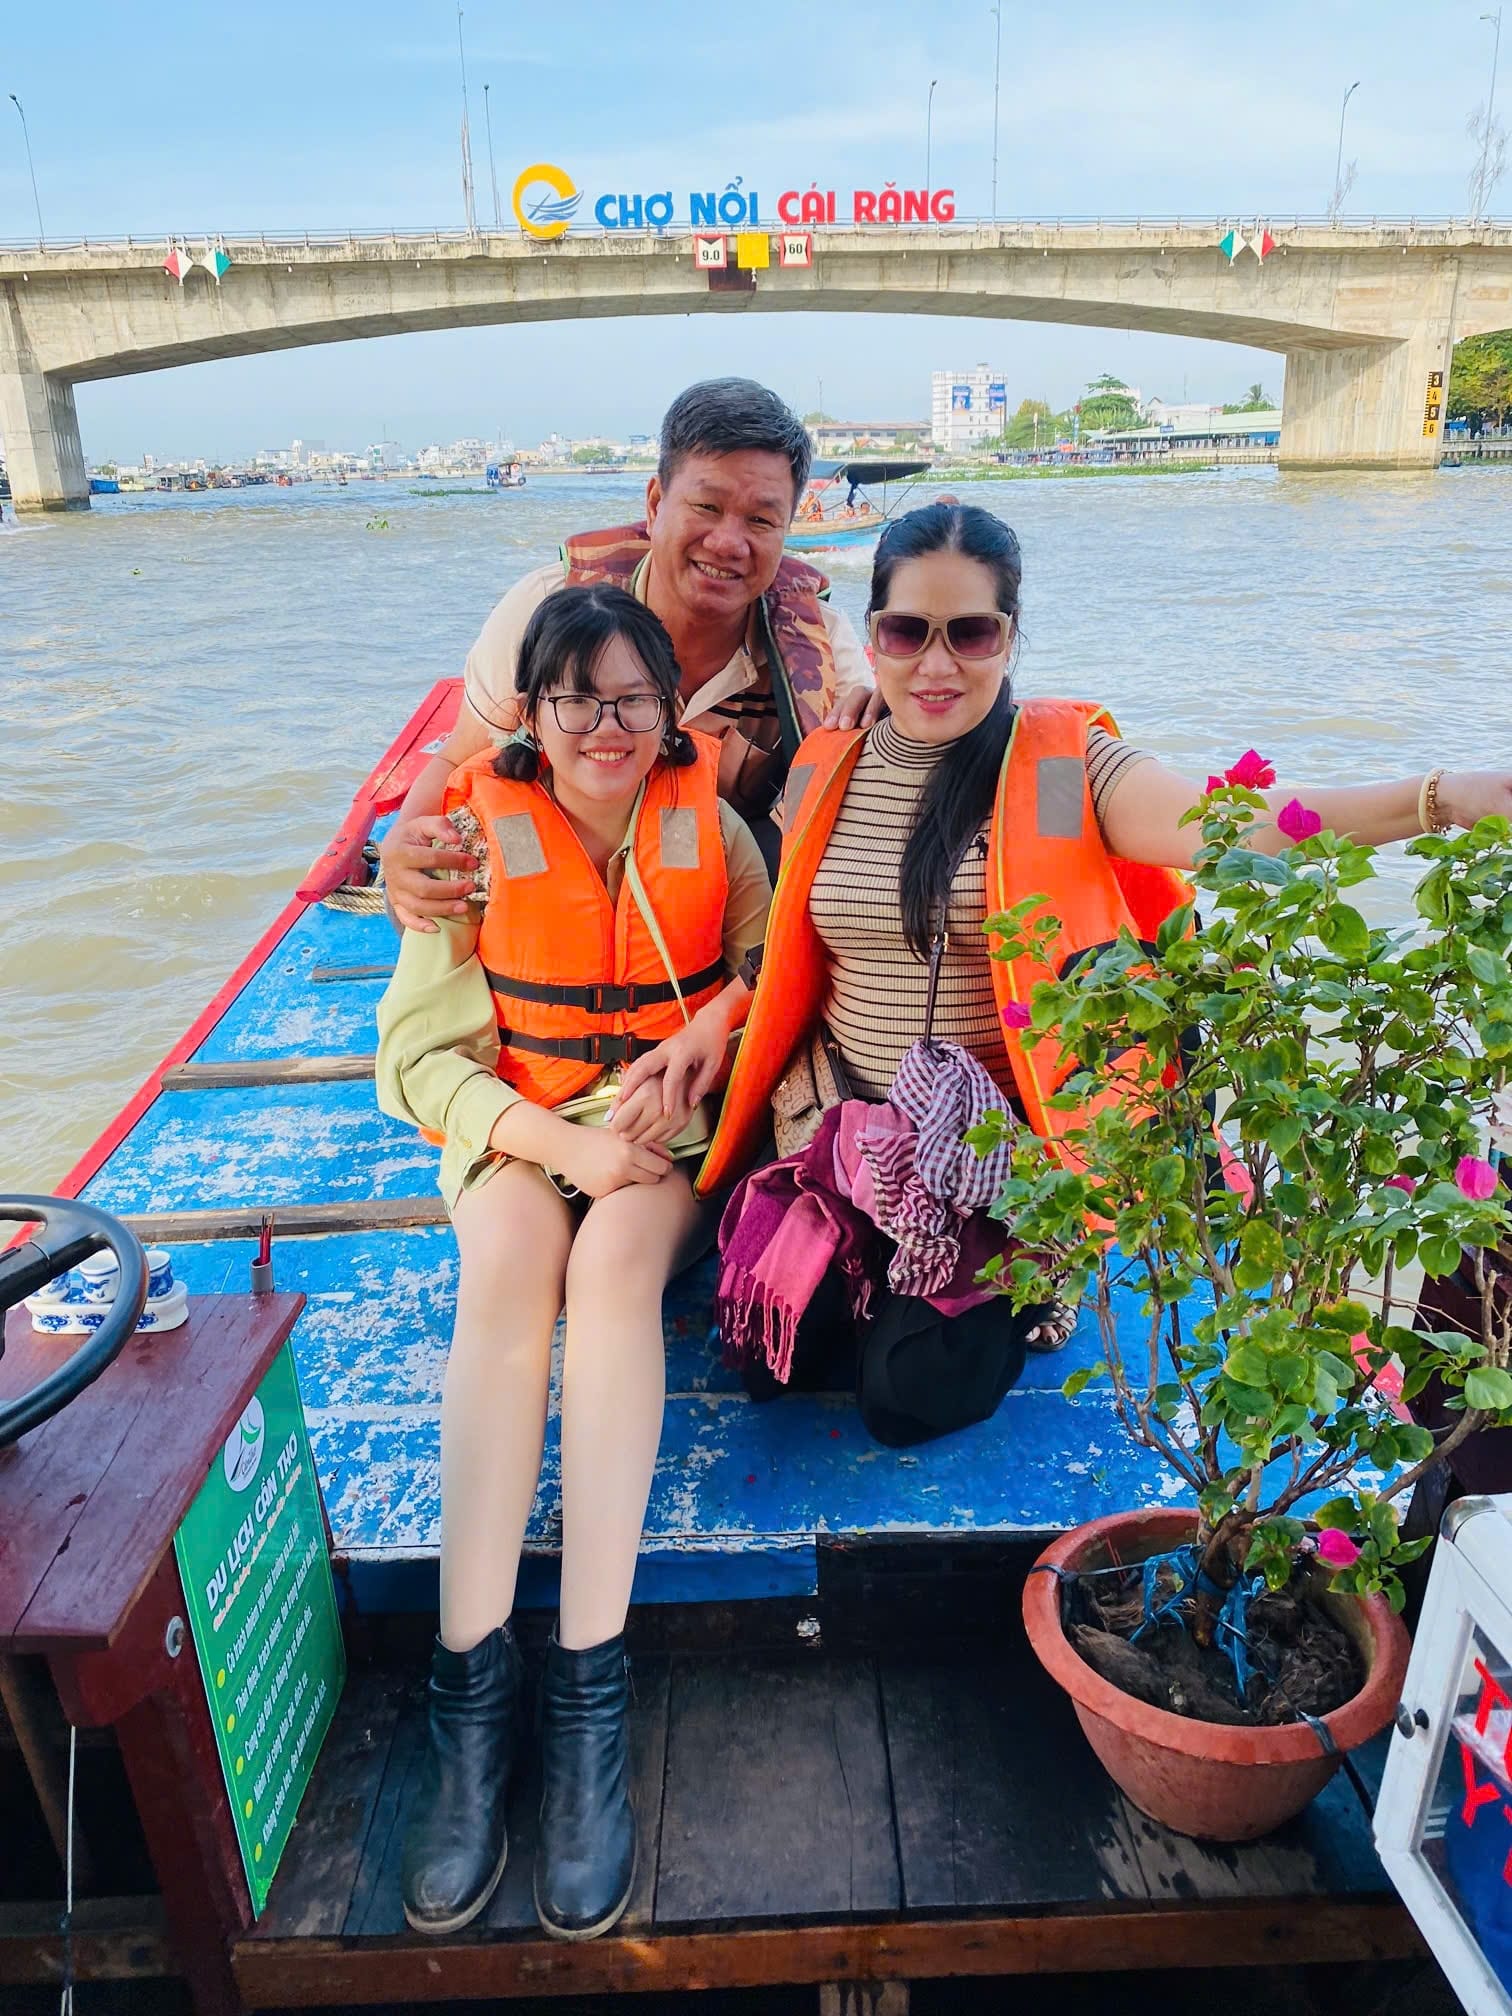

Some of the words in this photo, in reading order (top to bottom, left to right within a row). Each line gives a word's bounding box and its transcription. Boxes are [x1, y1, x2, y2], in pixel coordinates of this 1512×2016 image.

[594, 191, 674, 233] CHỢ
[690, 176, 759, 226] NỔI
[777, 181, 836, 224] CÁI
[854, 181, 956, 224] RĂNG
[702, 249, 721, 262] 9.0
[788, 242, 804, 255] 60
[206, 1561, 227, 1610] DU
[227, 1514, 254, 1572] LỊCH
[255, 1471, 277, 1522] CẦN
